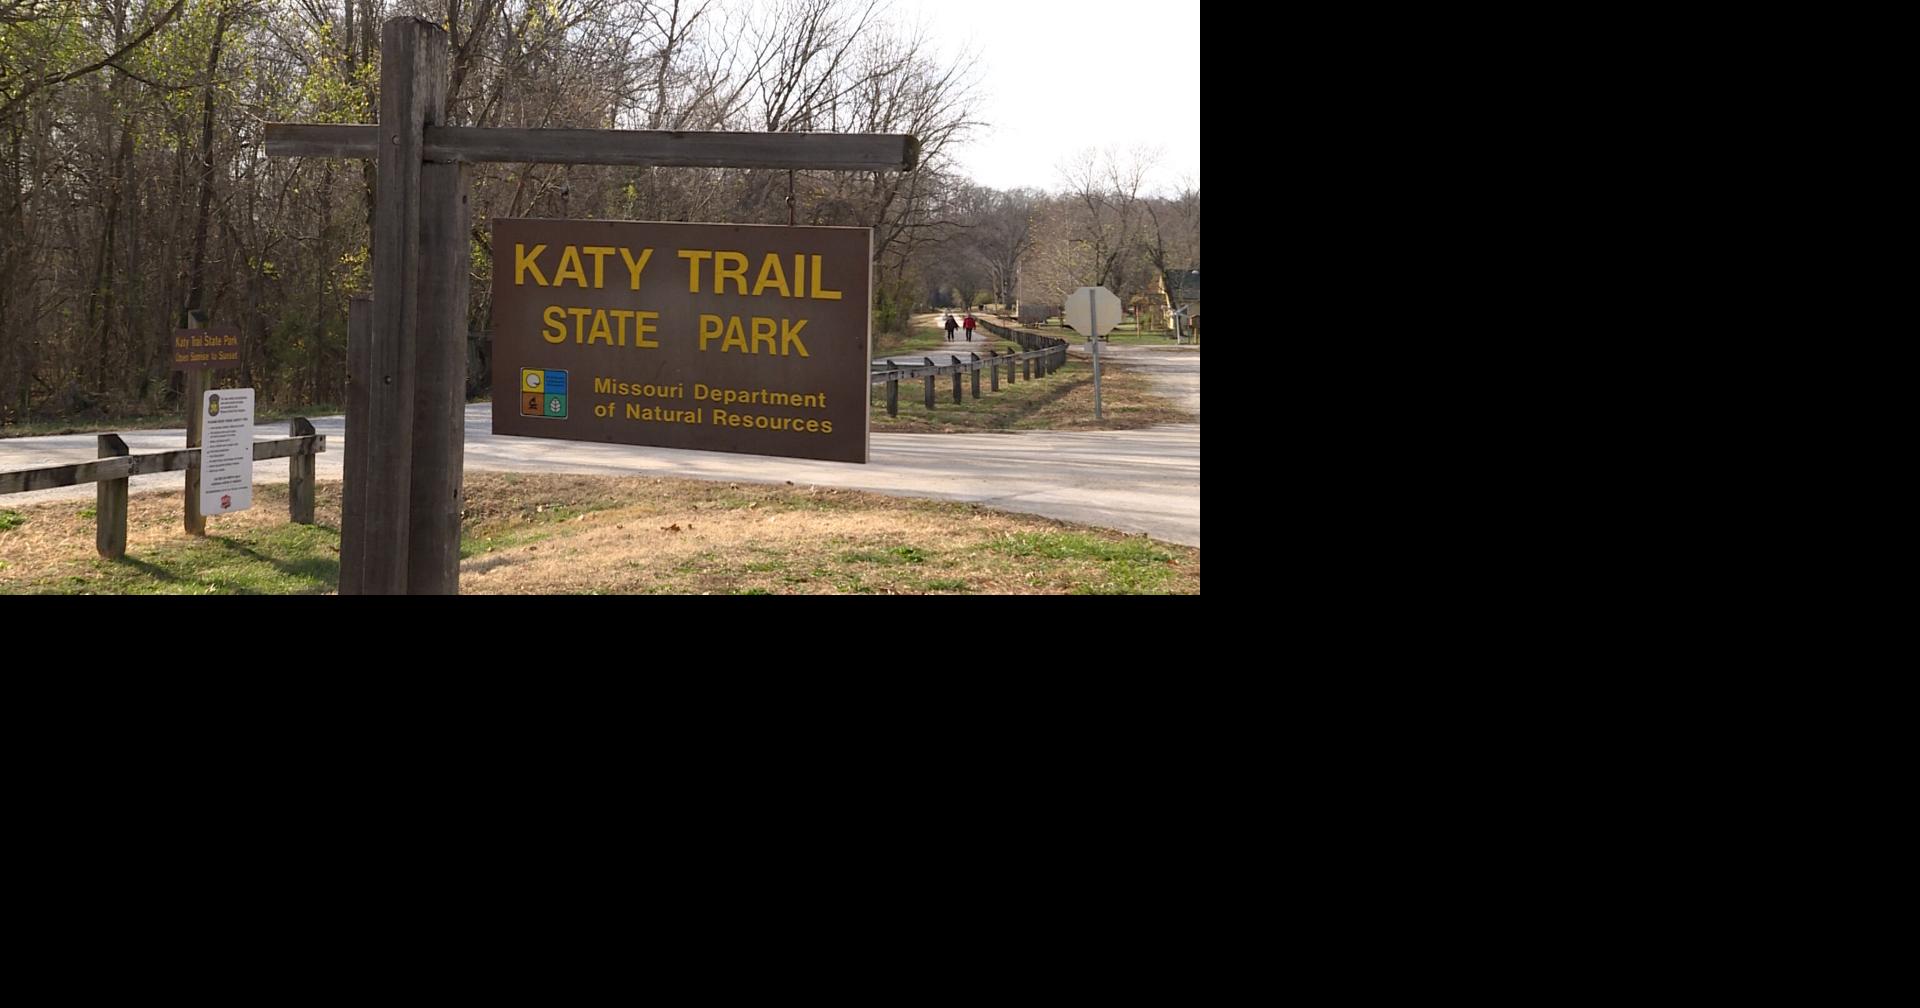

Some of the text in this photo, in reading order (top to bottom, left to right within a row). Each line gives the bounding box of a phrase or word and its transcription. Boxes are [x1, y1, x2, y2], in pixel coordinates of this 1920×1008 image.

[514, 243, 843, 301] KATY TRAIL
[176, 336, 189, 349] Katy
[203, 335, 222, 346] State
[223, 334, 238, 345] Park
[542, 305, 810, 358] STATE PARK
[594, 377, 827, 408] Missouri Department
[594, 402, 833, 434] of Natural Resources
